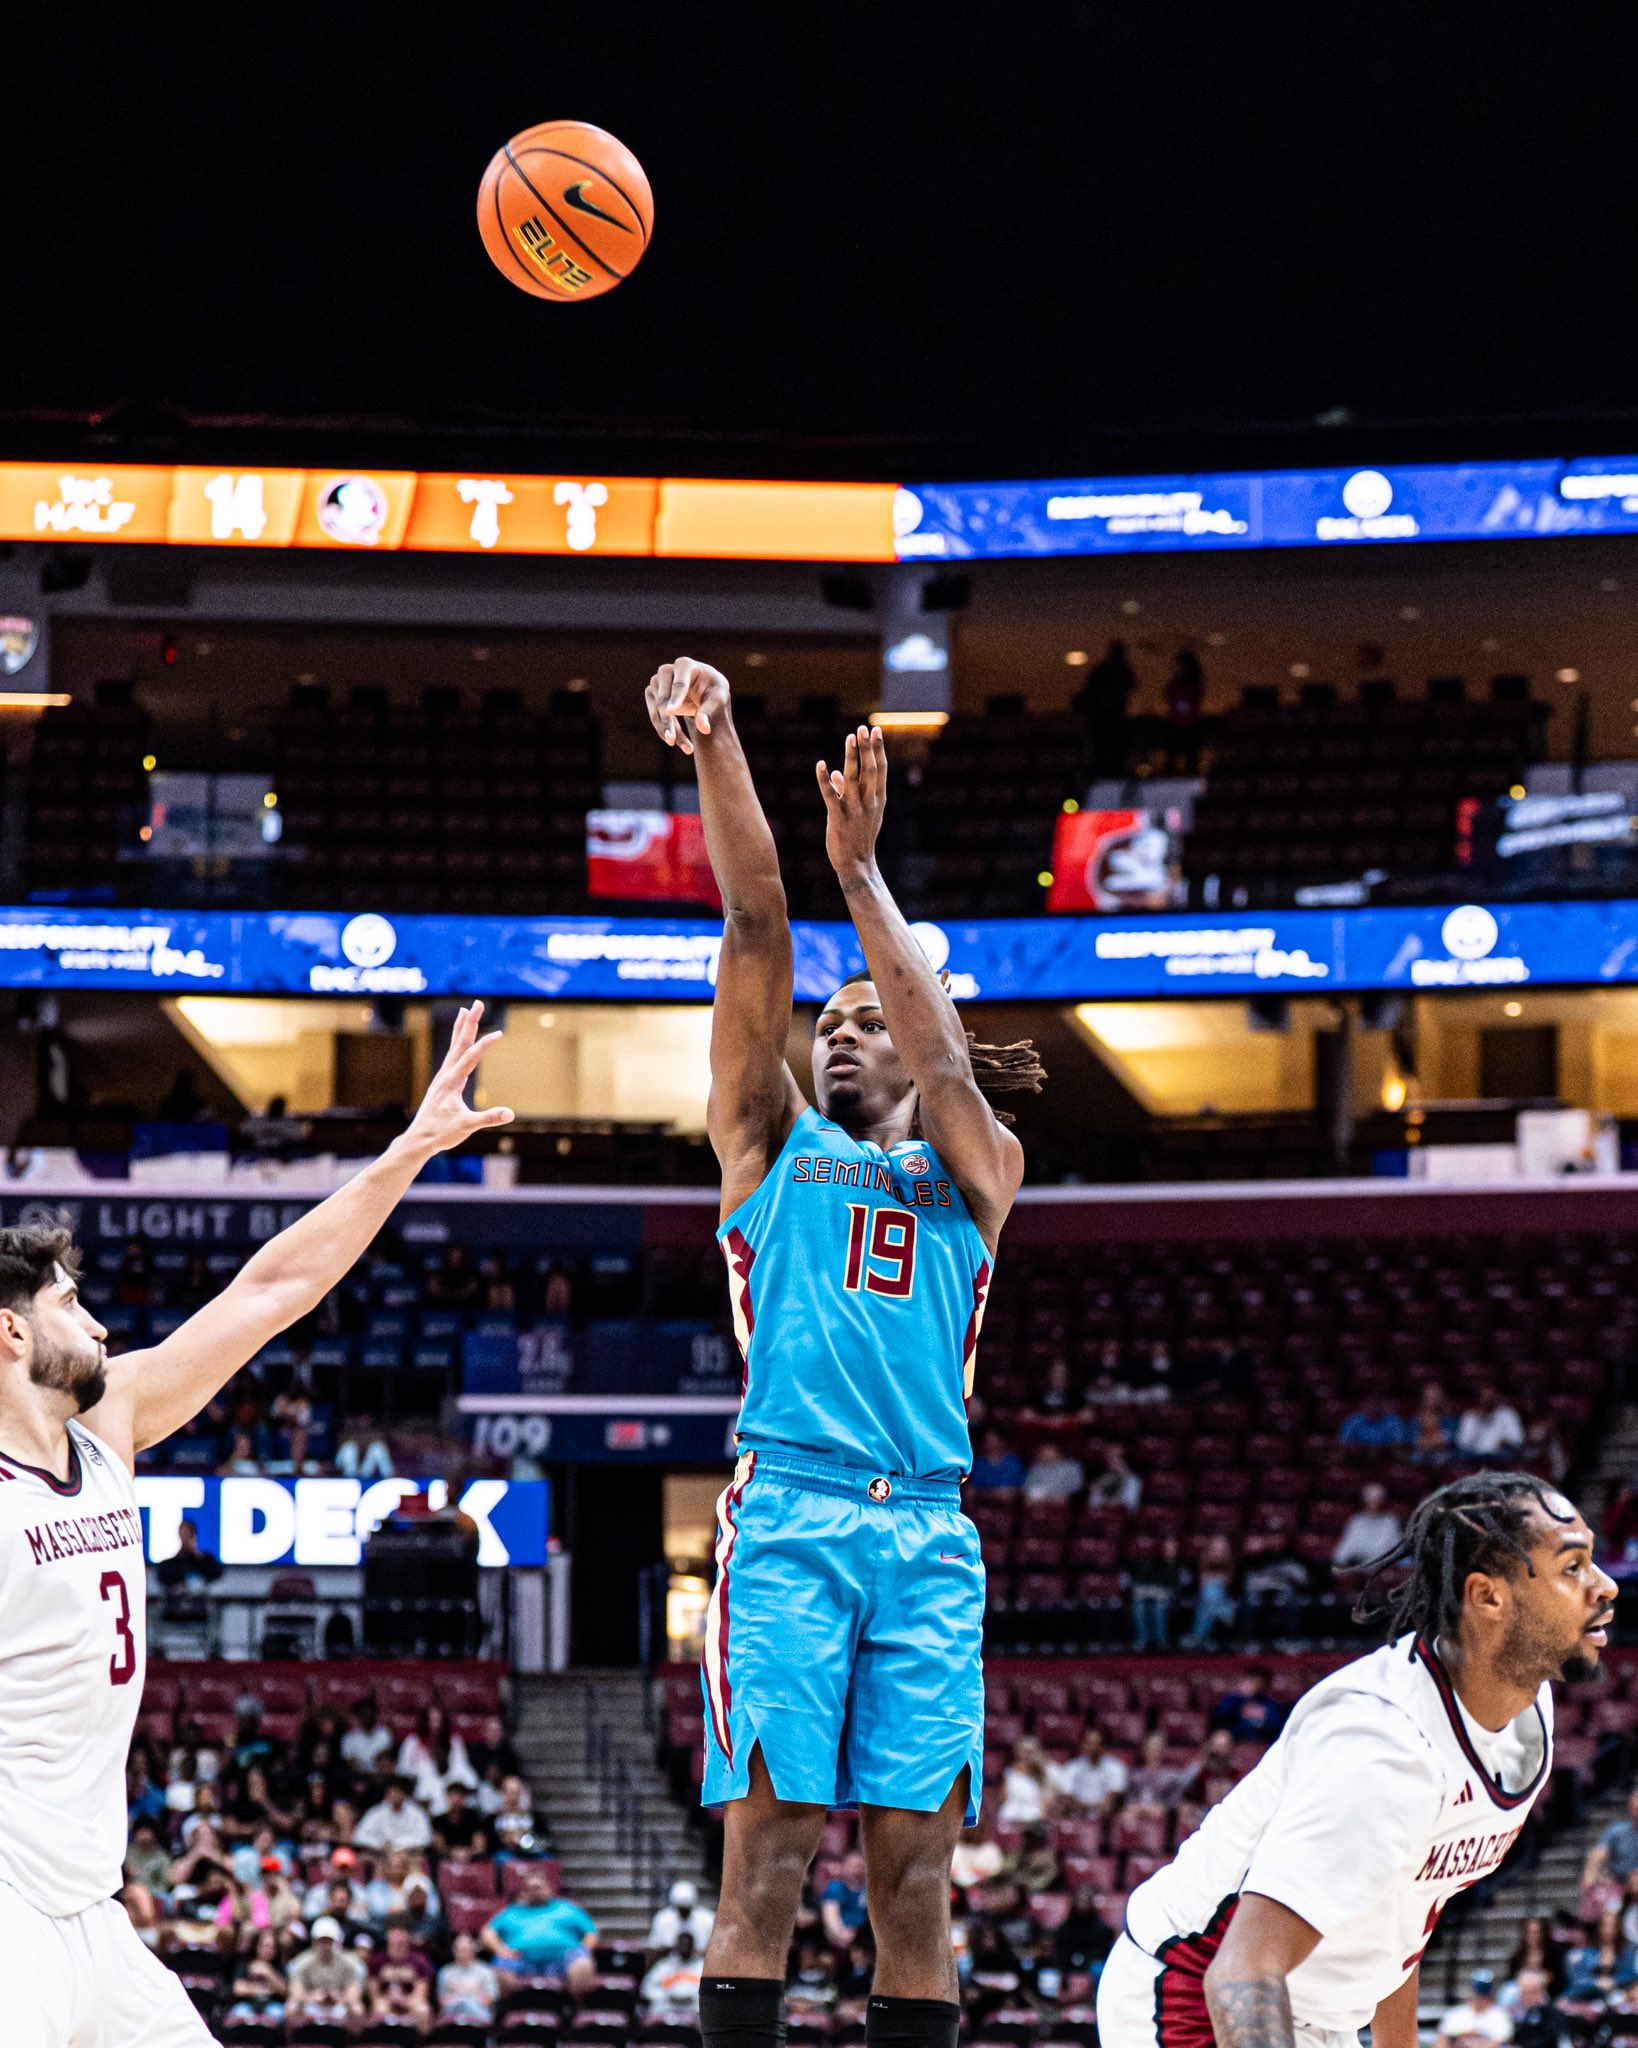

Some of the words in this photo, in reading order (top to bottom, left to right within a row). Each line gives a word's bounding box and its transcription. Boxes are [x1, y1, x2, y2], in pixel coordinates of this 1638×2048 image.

[515, 214, 594, 289] ELITE
[99, 1203, 231, 1239] LIGHT
[843, 1203, 918, 1298] 19
[472, 1414, 551, 1456] 109
[100, 1570, 136, 1686] 3
